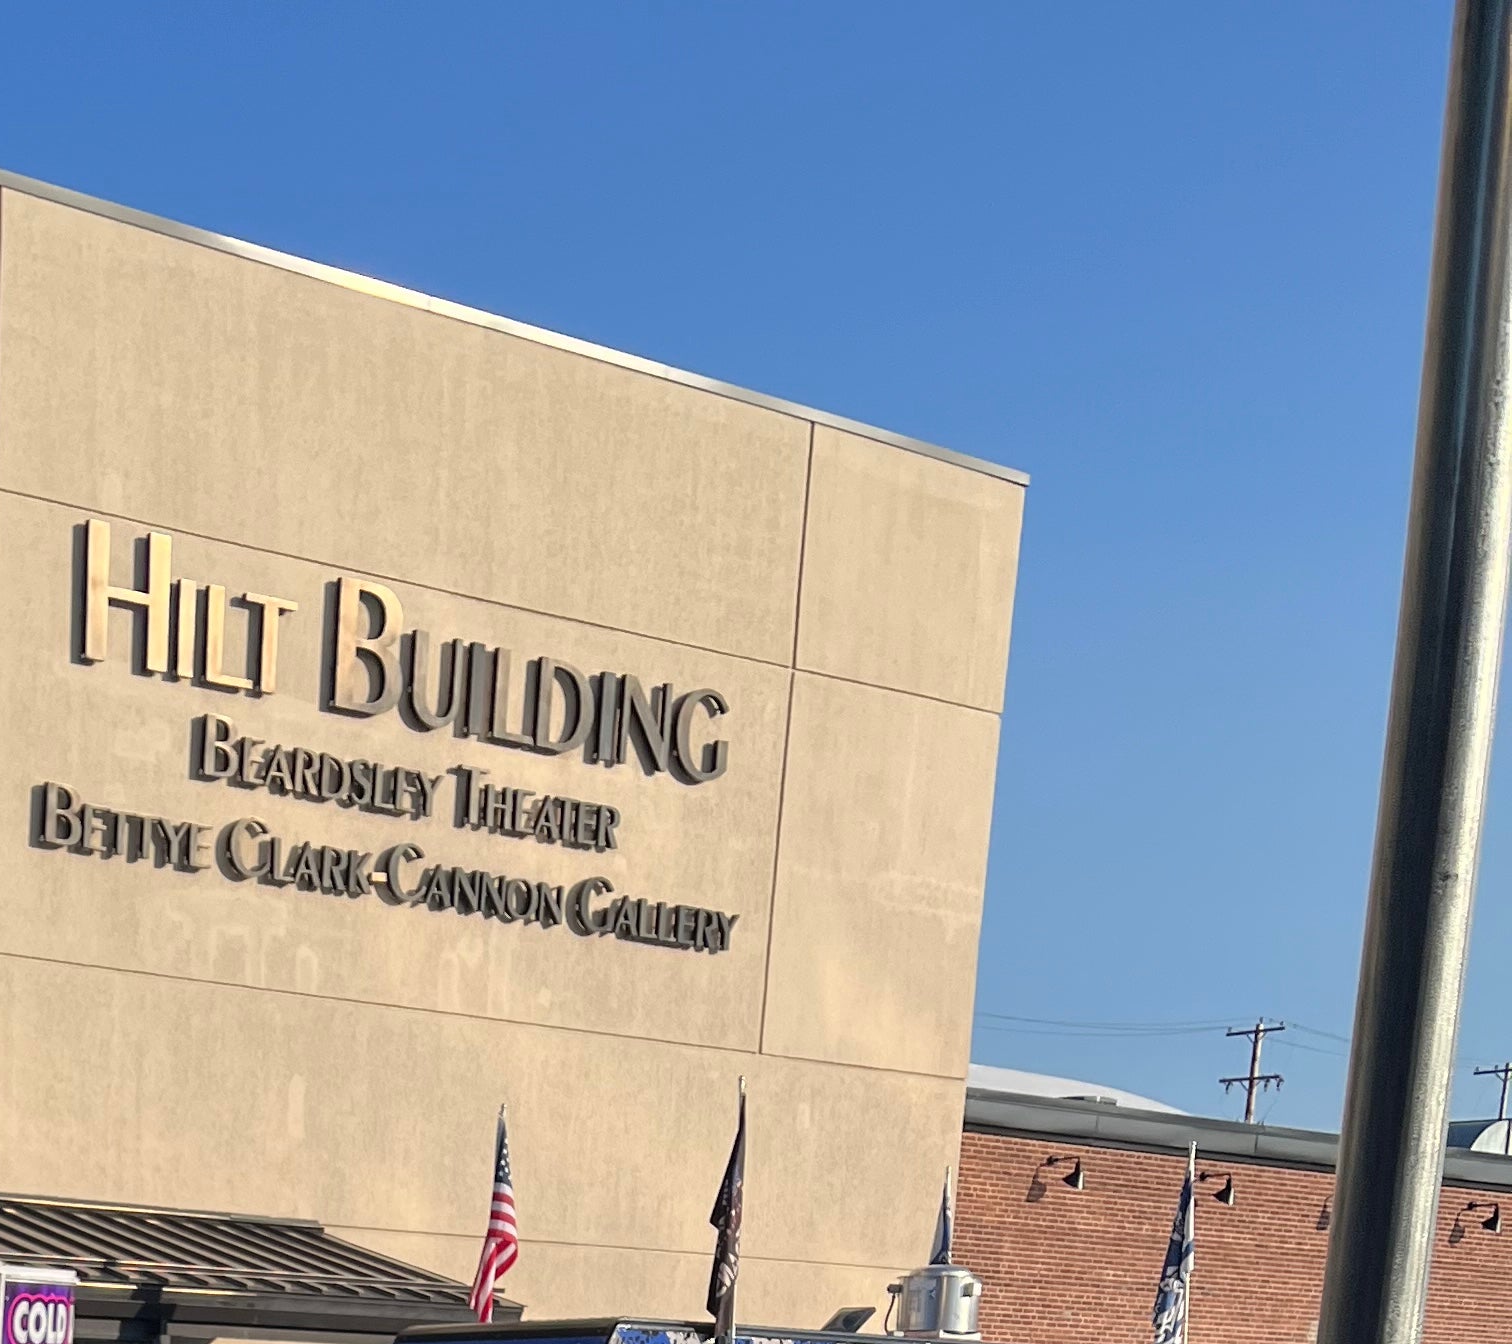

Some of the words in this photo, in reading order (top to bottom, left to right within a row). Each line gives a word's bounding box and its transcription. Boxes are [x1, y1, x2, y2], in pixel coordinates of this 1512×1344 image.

[80, 518, 299, 695] HILT
[325, 575, 730, 785] BUILDING
[34, 780, 215, 872] BETTYE
[218, 815, 565, 927] CLARK-CANNON
[568, 875, 741, 955] GALLERY
[196, 713, 445, 815] BEARDSLEY
[454, 762, 621, 851] THEATER
